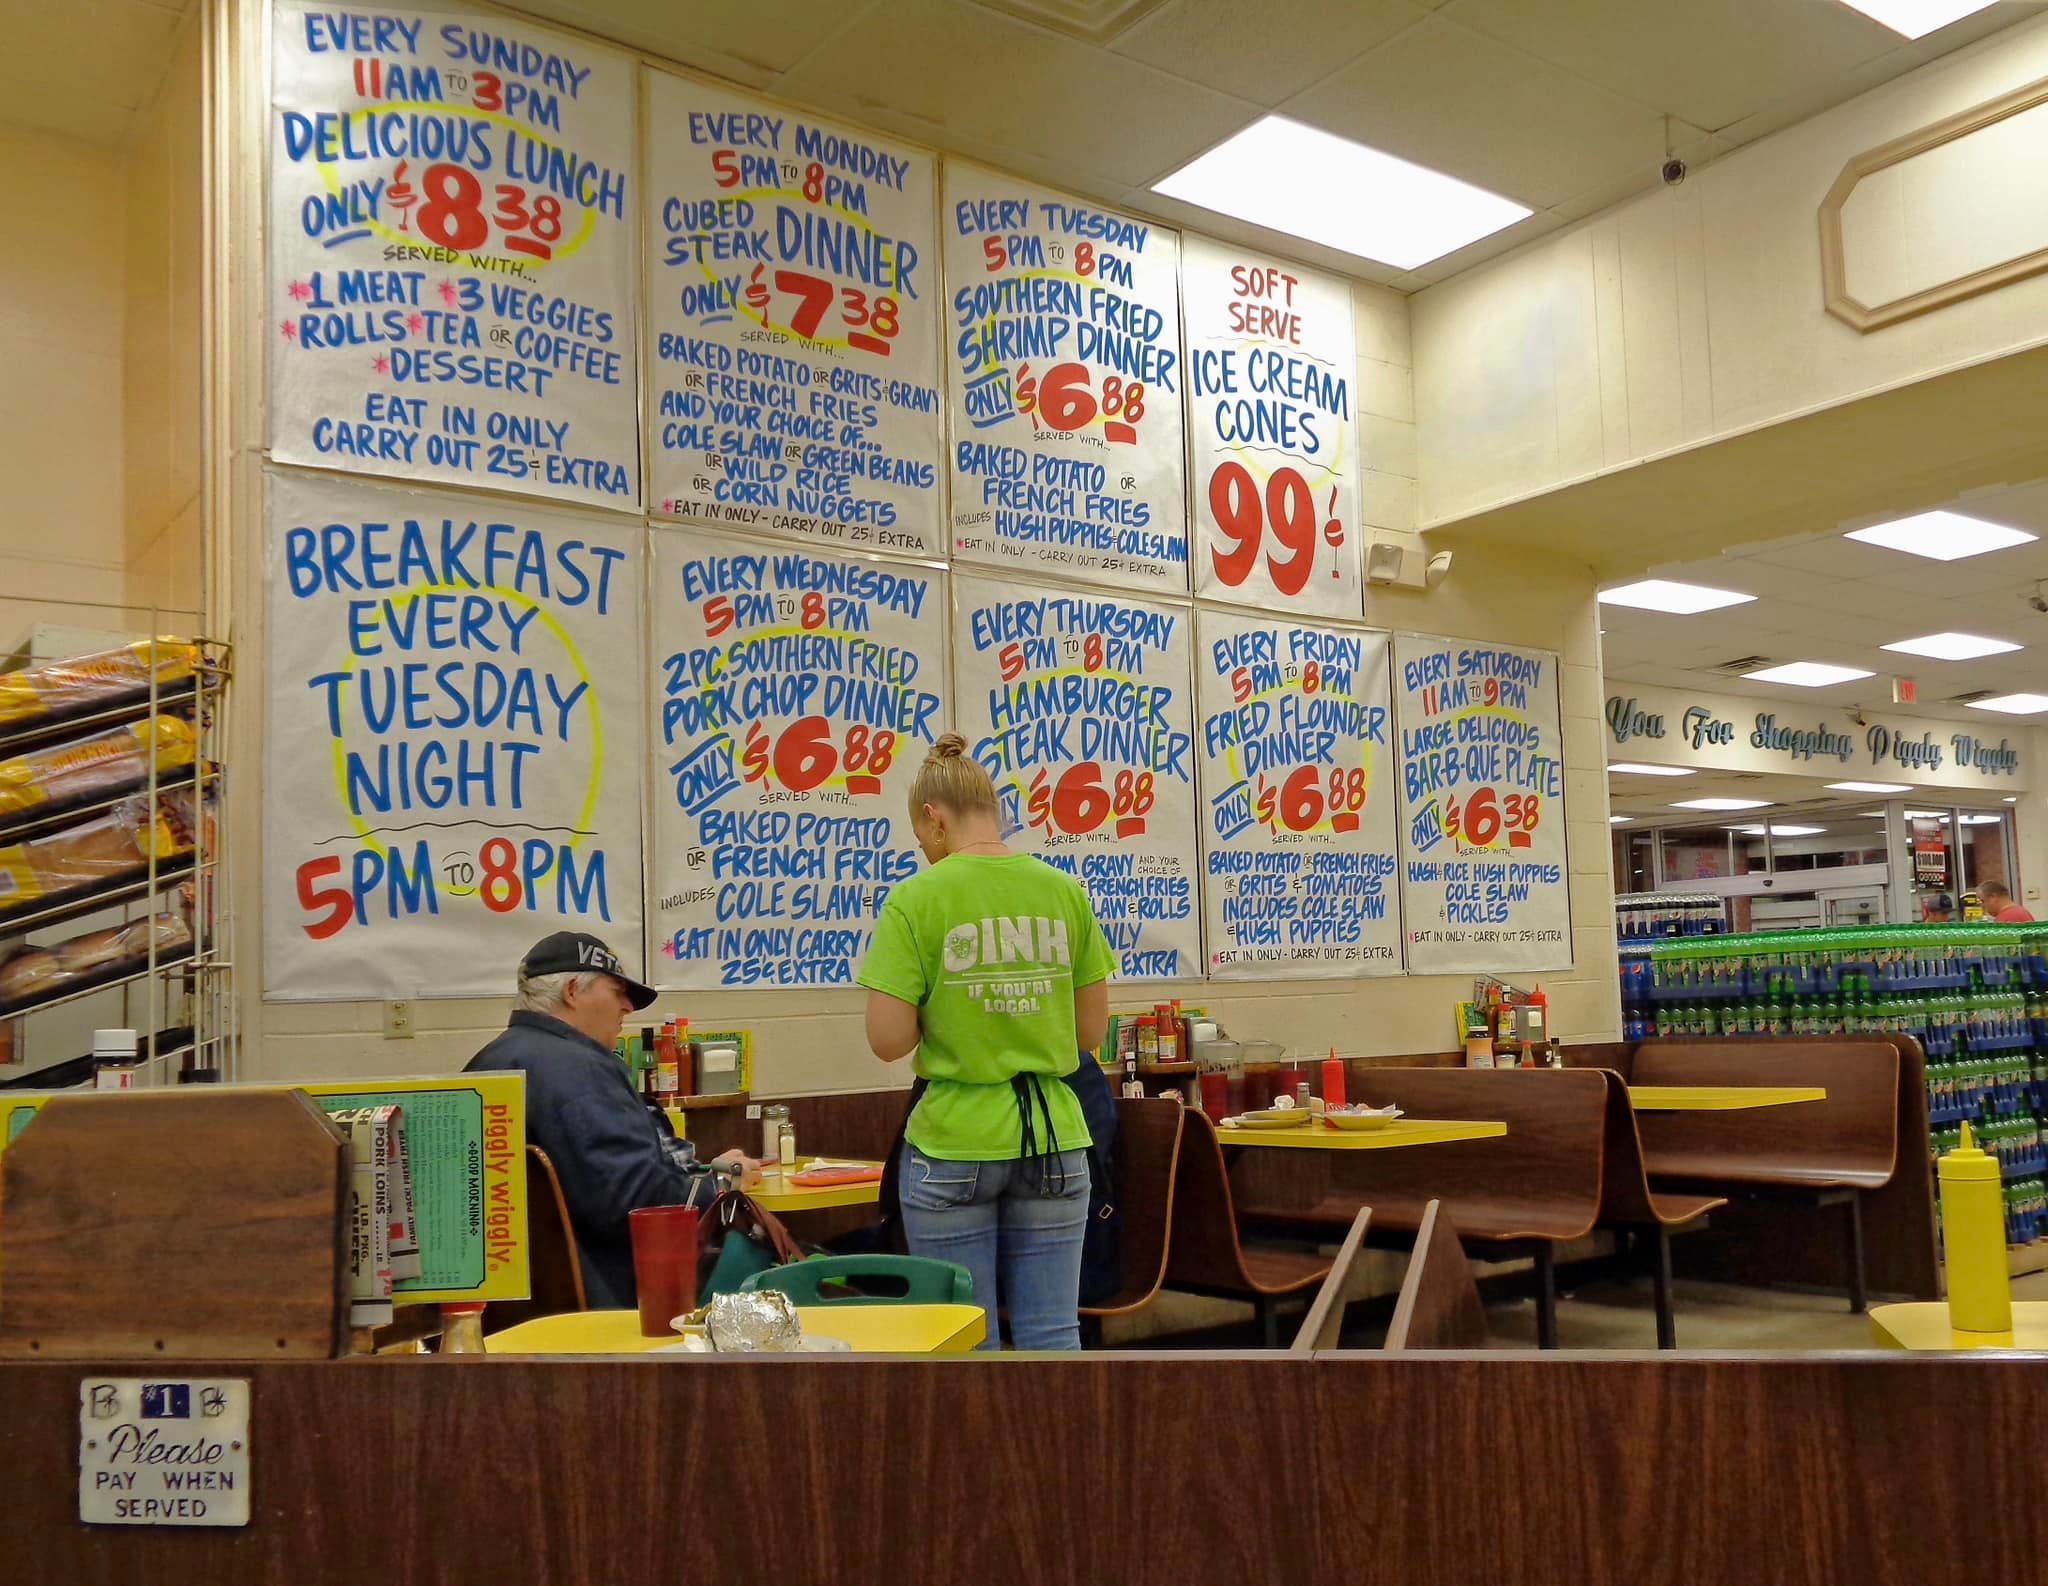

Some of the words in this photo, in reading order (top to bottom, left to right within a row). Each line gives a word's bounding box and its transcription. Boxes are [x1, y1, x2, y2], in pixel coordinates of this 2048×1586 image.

[304, 12, 422, 55] EVERY
[440, 25, 590, 99] SUNDAY
[282, 112, 493, 172] DELICIOUS
[505, 131, 625, 220] LUNCH
[688, 112, 783, 151] EVERY
[795, 124, 909, 192] MONDAY
[302, 177, 385, 238] ONLY
[663, 197, 754, 231] CUBED
[956, 199, 1029, 236] EVERY
[1039, 203, 1148, 254] TUESDAY
[384, 246, 459, 263] SERVED
[663, 230, 773, 266] STEAK
[776, 205, 918, 300] DINNER
[338, 270, 426, 306] MEAT
[491, 283, 613, 342] VEGGIES
[681, 274, 741, 316] ONLY
[954, 277, 1083, 327] SOUTHERN
[1089, 287, 1164, 343] FRIED
[1230, 265, 1298, 307] SOFT
[300, 310, 407, 349] ROLLS
[421, 310, 481, 348] TEA
[515, 325, 621, 384] COFFEE
[740, 331, 790, 345] SERVED
[1228, 301, 1302, 345] SERVE
[390, 348, 552, 397] DESSERT
[658, 333, 731, 371] BAKED
[737, 348, 810, 386] POTATO
[830, 367, 881, 401] GRITS
[957, 315, 1071, 375] SHRIMP
[1077, 321, 1177, 394] DINNER
[706, 372, 796, 412] FRENCH
[810, 391, 878, 427] FRIES
[964, 376, 1013, 418] ONLY
[1192, 349, 1238, 397] ICE
[1248, 348, 1349, 422] CREAM
[366, 393, 427, 429] EAT
[442, 405, 476, 435] IN
[487, 412, 569, 452] ONLY
[660, 390, 705, 419] AND
[709, 400, 762, 430] YOUR
[767, 413, 835, 442] CHOICE
[1033, 432, 1074, 441] SERVED
[1216, 399, 1320, 455] CONES
[313, 417, 418, 464] CARRY
[426, 435, 480, 472] OUT
[546, 455, 630, 495] EXTRA
[662, 423, 715, 452] COLE
[719, 430, 783, 460] SLAW
[802, 444, 865, 477] GREEN
[869, 455, 935, 489] BEANS
[723, 457, 787, 483] WILD
[796, 468, 850, 496] RICE
[957, 440, 1027, 480] BAKED
[1032, 453, 1106, 493] POTATO
[673, 500, 701, 515] EAT
[705, 503, 721, 518] IN
[725, 507, 761, 523] ONLY
[772, 514, 818, 533] CARRY
[822, 522, 847, 537] OUT
[879, 532, 925, 550] EXTRA
[714, 478, 778, 507] CORN
[786, 488, 897, 527] NUGGETS
[983, 477, 1075, 517] FRENCH
[1085, 494, 1150, 527] FRIES
[285, 520, 625, 615] BREAKFAST
[965, 538, 982, 549] EAT
[985, 542, 996, 553] IN
[1000, 545, 1025, 558] ONLY
[1039, 550, 1074, 564] CARRY
[1077, 555, 1098, 566] OUT
[1129, 562, 1166, 577] EXTRA
[682, 555, 768, 602] EVERY
[773, 555, 928, 620] WEDNESDAY
[348, 594, 540, 657] EVERY
[971, 598, 1046, 651] EVERY
[1048, 599, 1175, 651] THURSDAY
[727, 634, 843, 678] SOUTHERN
[848, 638, 919, 686] FRIED
[1212, 630, 1278, 676] EVERY
[1288, 629, 1361, 672] FRIDAY
[1404, 650, 1451, 692] EVERY
[1457, 649, 1542, 689] SATURDAY
[308, 661, 589, 743] TUESDAY
[662, 681, 743, 746] PORK
[742, 673, 819, 721] CHOP
[824, 675, 941, 746] DINNER
[989, 674, 1172, 732] HAMBURGER
[1204, 701, 1270, 759] FRIED
[1279, 693, 1386, 745] FLOUNDER
[1080, 717, 1190, 784] DINNER
[1243, 731, 1336, 778] DINNER
[1457, 716, 1540, 751] DELICIOUS
[1605, 696, 1666, 743] You
[1682, 705, 1735, 750] For
[1750, 712, 1854, 762] Shopping
[1866, 724, 1943, 772] Piggly
[1950, 734, 2019, 776] Wiggly
[347, 739, 541, 817] NIGHT
[1506, 747, 1560, 798] PLATE
[759, 792, 811, 806] SERVED
[699, 809, 791, 847] BAKED
[796, 812, 891, 849] POTATO
[1044, 833, 1082, 848] SERVED
[712, 844, 826, 881] FRENCH
[834, 848, 919, 883] FRIES
[1088, 877, 1144, 897] FRENCH
[1147, 876, 1190, 896] FRIES
[1239, 875, 1287, 896] GRITS
[1301, 874, 1382, 896] TOMATOES
[1255, 852, 1300, 873] POTATO
[1313, 852, 1360, 875] FRENCH
[1360, 853, 1395, 875] FRIES
[1443, 863, 1469, 882] RICE
[1473, 864, 1506, 883] HUSH
[1509, 863, 1560, 884] PUPPIES
[716, 881, 785, 923] COLE
[791, 883, 863, 921] SLAW
[1445, 883, 1481, 902] COLE
[1485, 884, 1529, 903] SLAW
[1447, 903, 1509, 924] PICKLES
[1220, 951, 1237, 963] EAT
[1242, 950, 1253, 961] IN
[1257, 949, 1282, 961] ONLY
[1290, 948, 1320, 960] CARRY
[1324, 949, 1342, 960] OUT
[1363, 947, 1394, 960] EXTRA
[1414, 930, 1432, 943] EAT
[1433, 931, 1443, 942] IN
[1474, 931, 1500, 943] CARRY
[778, 959, 852, 985] EXTRA
[968, 984, 984, 998] IF
[984, 997, 1041, 1013] LOCAL
[375, 1127, 385, 1167] PORK
[484, 1104, 515, 1174] piggly
[375, 1173, 385, 1214] LOINS
[468, 1177, 480, 1229] MORNING
[487, 1183, 517, 1264] wiggly
[108, 1423, 225, 1465] Please
[96, 1471, 137, 1490] PAY
[163, 1471, 234, 1490] WHEN
[115, 1498, 208, 1518] SERVED
